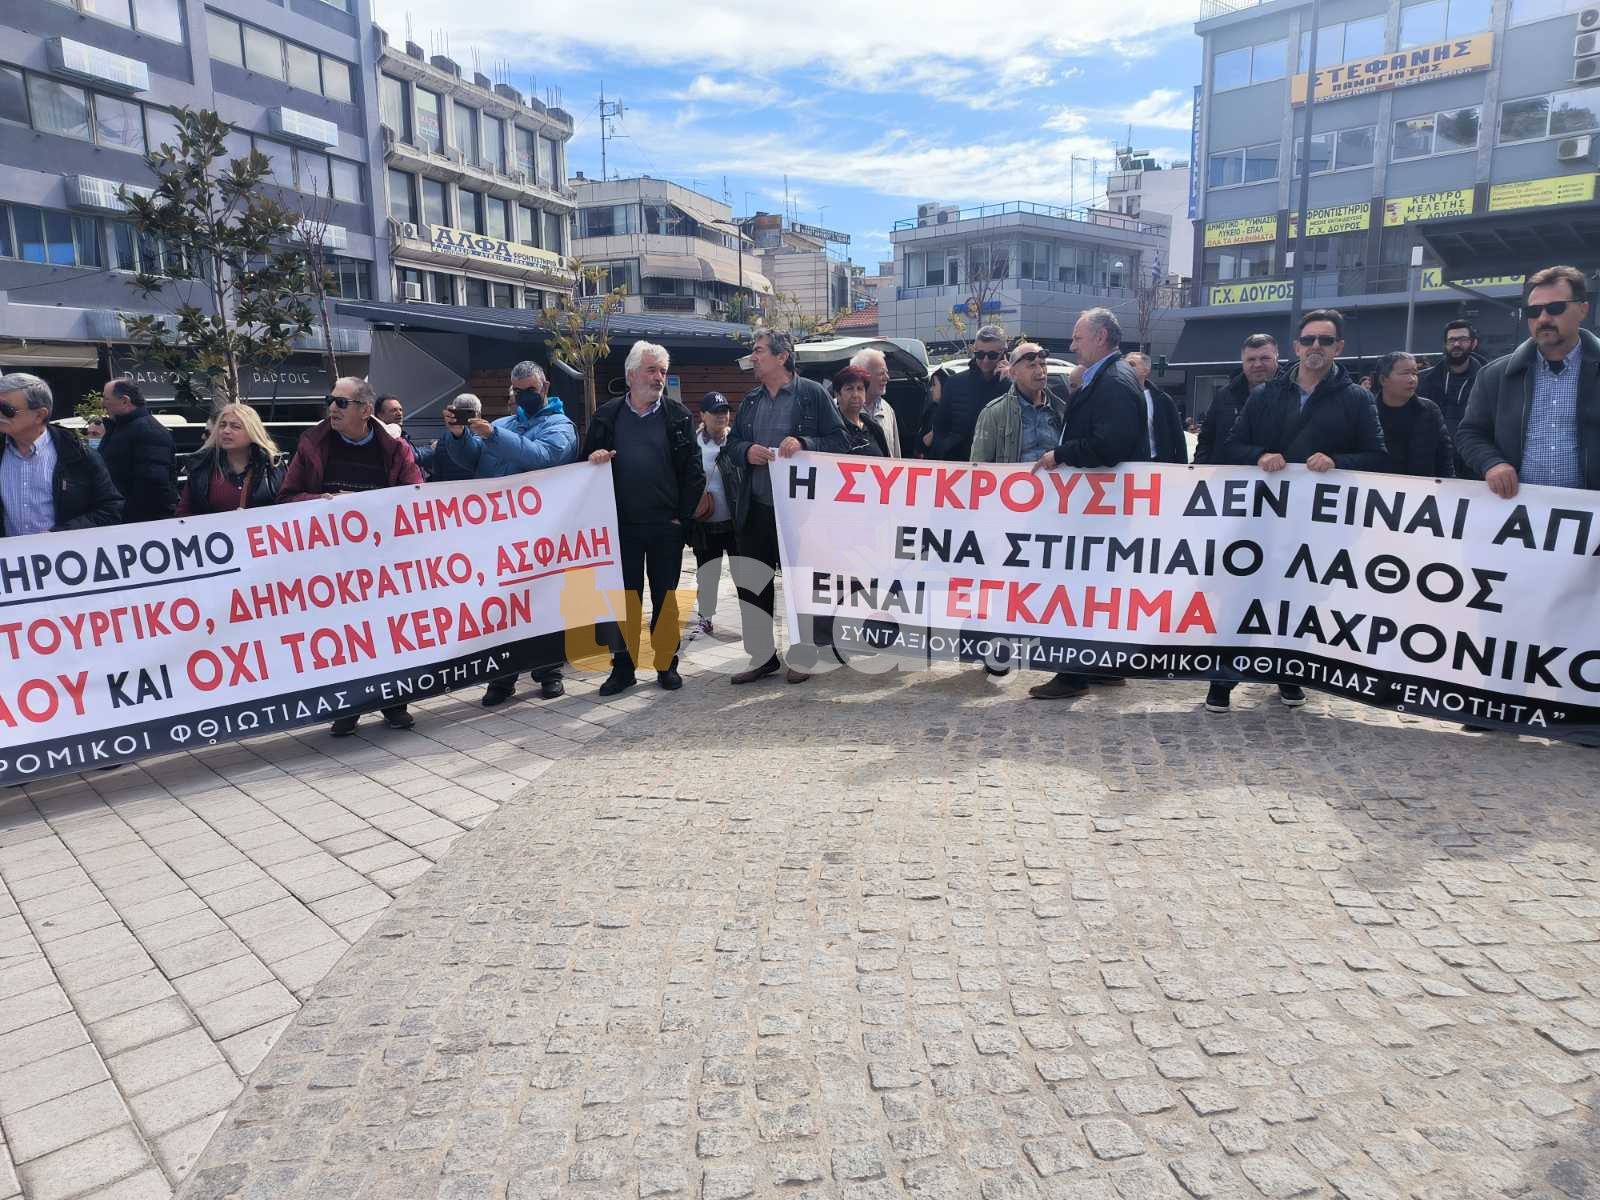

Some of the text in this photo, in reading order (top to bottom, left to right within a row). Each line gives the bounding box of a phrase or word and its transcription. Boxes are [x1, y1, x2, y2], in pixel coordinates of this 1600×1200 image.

[1313, 39, 1472, 87] ΣΤΕΦΑΝΗΣ
[1332, 62, 1441, 91] ΠΑΝΑΓΙΩΤΗΣ
[1407, 199, 1465, 214] ΜΕΛΕΤΗΣ
[1413, 191, 1462, 204] ΚΕΝΤΡΟ
[434, 228, 513, 257] ΑΛΦΑ
[1219, 228, 1241, 237] ΛΥΚΕΙΟ
[1247, 226, 1264, 234] ΕΠΑΛ
[1328, 222, 1361, 232] ΔΟΥΡΟΣ
[1240, 283, 1295, 303] ΔΟΥΡΟΣ
[789, 461, 1600, 556] Η ΣΥΓΚΡΟΥΣΗ ΔΕΝ ΕΙΝΑΙ ΑΠ
[0, 485, 542, 595] ΗΡΟΔΡΟΜΟ ΕΝΙΑΙΟ, ΔΗΜΟΣΙΟ
[229, 552, 485, 624] ΔΗΜΟΚΡΑΤΙΚΟ,
[496, 526, 611, 577] ΑΣΦΑΛΗ
[894, 526, 1508, 613] ΕΝΑ ΣΤΙΓΜΙΑΙΟ ΛΑΘΟΣ
[107, 664, 173, 709] ΚΑΙ
[186, 640, 269, 692] ΟΧΙ
[281, 620, 377, 674] ΤΩΝ
[387, 589, 533, 655] ΚΕΡΔΩΝ
[811, 571, 1600, 693] ΕΙΝΑΙ ΕΓΚΛΗΜΑ ΔΙΑΧΡΟΝΙΚΟ
[840, 624, 1001, 657] ΣΥΝΤΑΞΙΟΥΧΟΙ
[1011, 642, 1221, 672] ΣΙΔΗΡΟΔΡΟΜΙΚΟΙ
[1232, 655, 1379, 696] ΦΘΙΩΤΙΔΑΣ
[170, 690, 352, 743] ΦΘΙΩΤΙΔΑΣ
